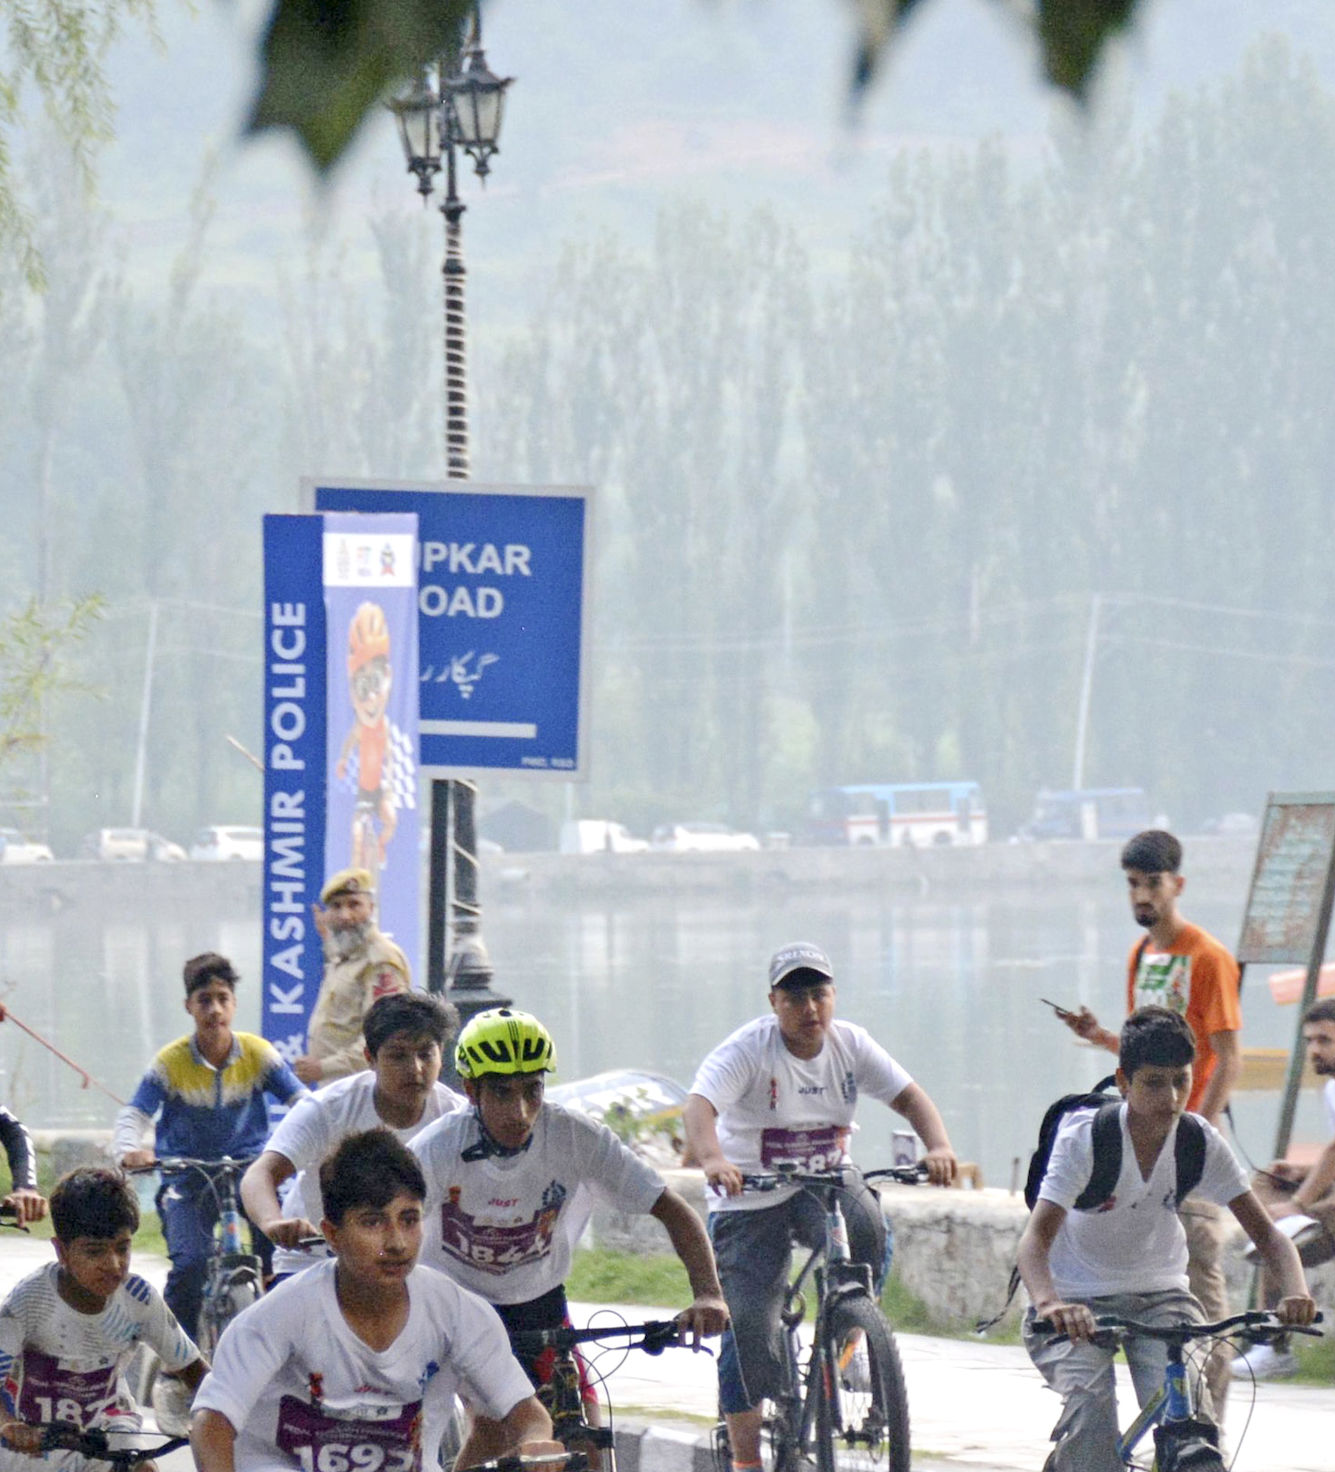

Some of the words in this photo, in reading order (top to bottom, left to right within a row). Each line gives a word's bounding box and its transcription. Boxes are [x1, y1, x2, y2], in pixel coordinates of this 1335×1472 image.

[416, 541, 532, 576] PKAR
[419, 585, 504, 619] OAD
[272, 602, 306, 770] POLICE
[270, 790, 305, 1014] KASHMIR
[488, 1198, 519, 1207] JUST
